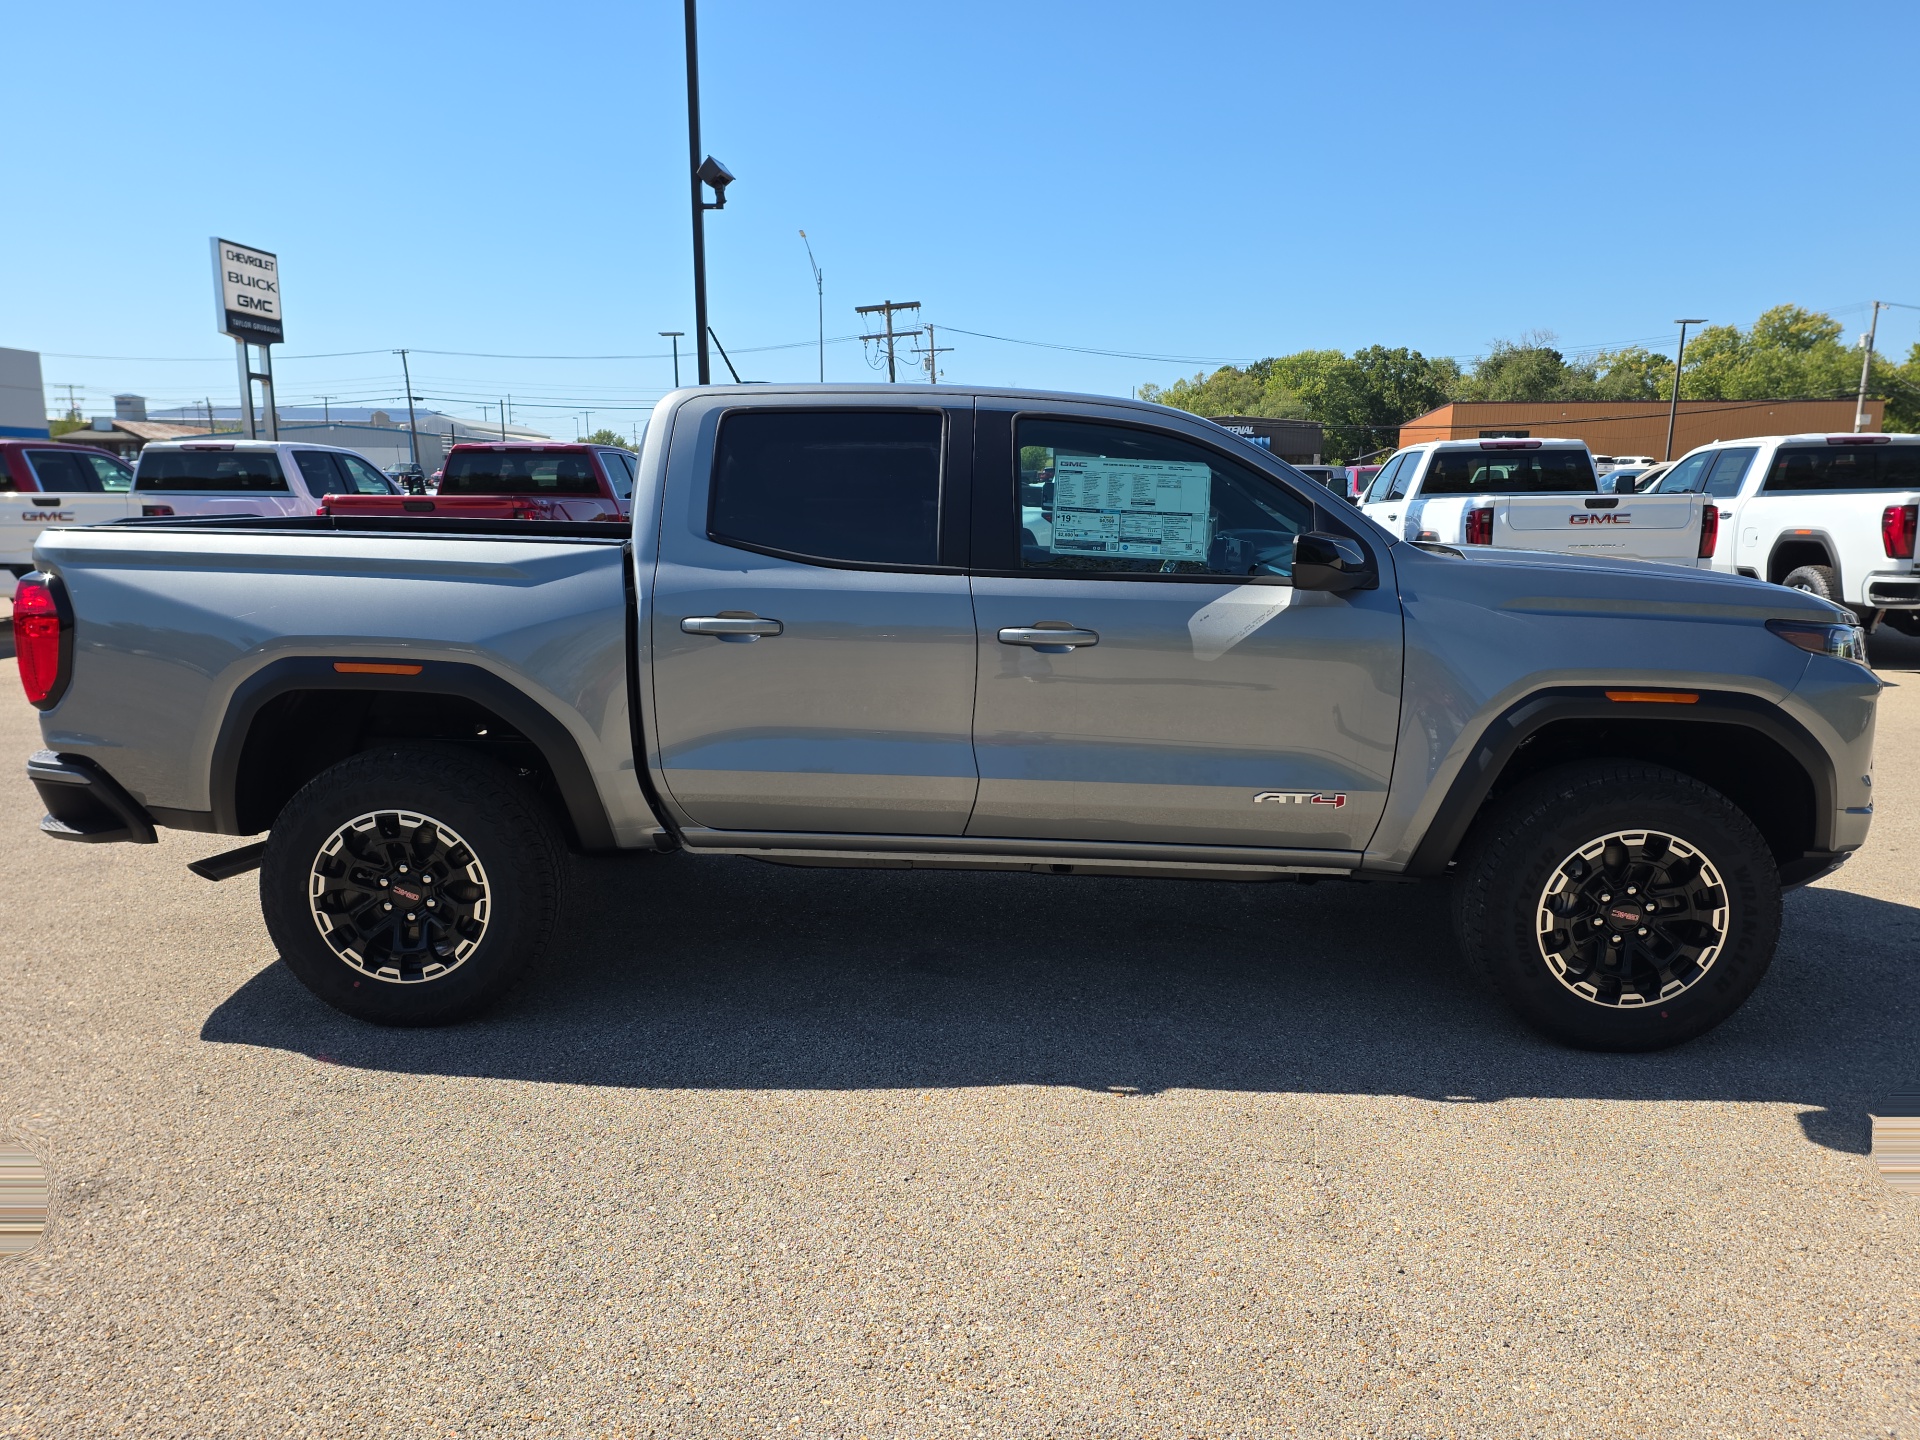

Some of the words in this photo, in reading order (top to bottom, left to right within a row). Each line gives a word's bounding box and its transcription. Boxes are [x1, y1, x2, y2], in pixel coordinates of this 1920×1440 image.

[226, 250, 275, 271] CHEVROLET
[228, 271, 277, 293] BUICK
[237, 294, 273, 313] GMC
[22, 511, 75, 522] GMC
[1061, 514, 1071, 522] 19
[1568, 513, 1632, 525] GMC
[1253, 791, 1347, 809] AT4
[393, 885, 420, 901] GMC
[1611, 909, 1640, 921] GMC
